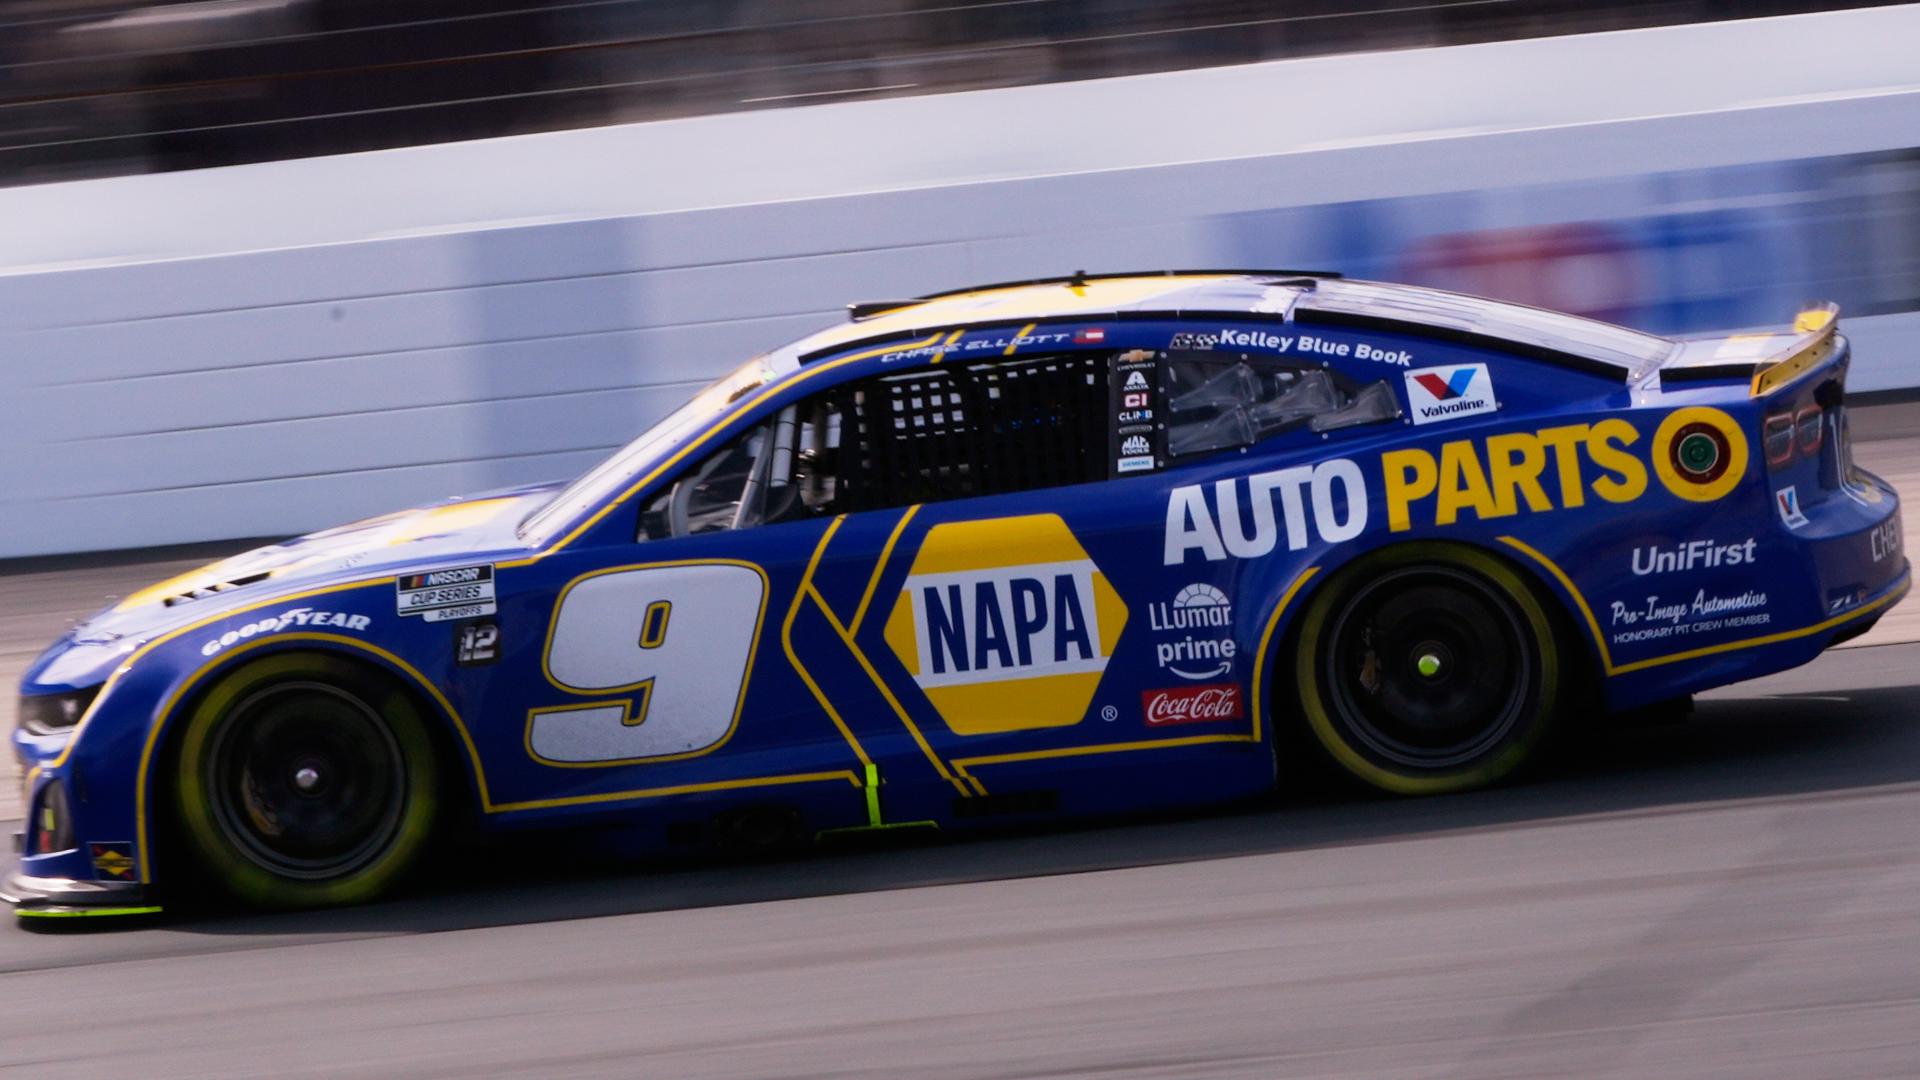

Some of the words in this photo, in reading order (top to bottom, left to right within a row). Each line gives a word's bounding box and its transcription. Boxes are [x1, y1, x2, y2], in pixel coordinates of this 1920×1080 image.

[881, 342, 961, 363] CHASE
[965, 333, 1069, 350] ELLIOTT
[1220, 329, 1290, 352] Kelley
[1297, 335, 1350, 357] Blue
[1354, 341, 1413, 367] Book
[1420, 400, 1486, 418] Valvoline
[1163, 459, 1369, 566] AUTO
[1381, 419, 1648, 533] PARTS
[1632, 537, 1757, 576] UniFirst
[429, 567, 480, 586] NASCAR
[411, 591, 437, 605] CUP
[438, 585, 482, 602] SERIES
[1611, 596, 1688, 625] Pro-Image
[1691, 588, 1768, 615] Automotive
[439, 605, 482, 619] PLAYOFFS
[922, 573, 1094, 675] NAPA
[1149, 602, 1232, 630] LLumar
[201, 607, 372, 656] GOODYEAR
[1614, 626, 1674, 644] HONORARY
[1675, 624, 1690, 635] PIT
[1692, 620, 1721, 633] CREW
[1724, 613, 1771, 628] MEMBER
[525, 558, 769, 768] 9
[1157, 636, 1236, 667] prime
[1148, 688, 1237, 722] Coca-Cola
